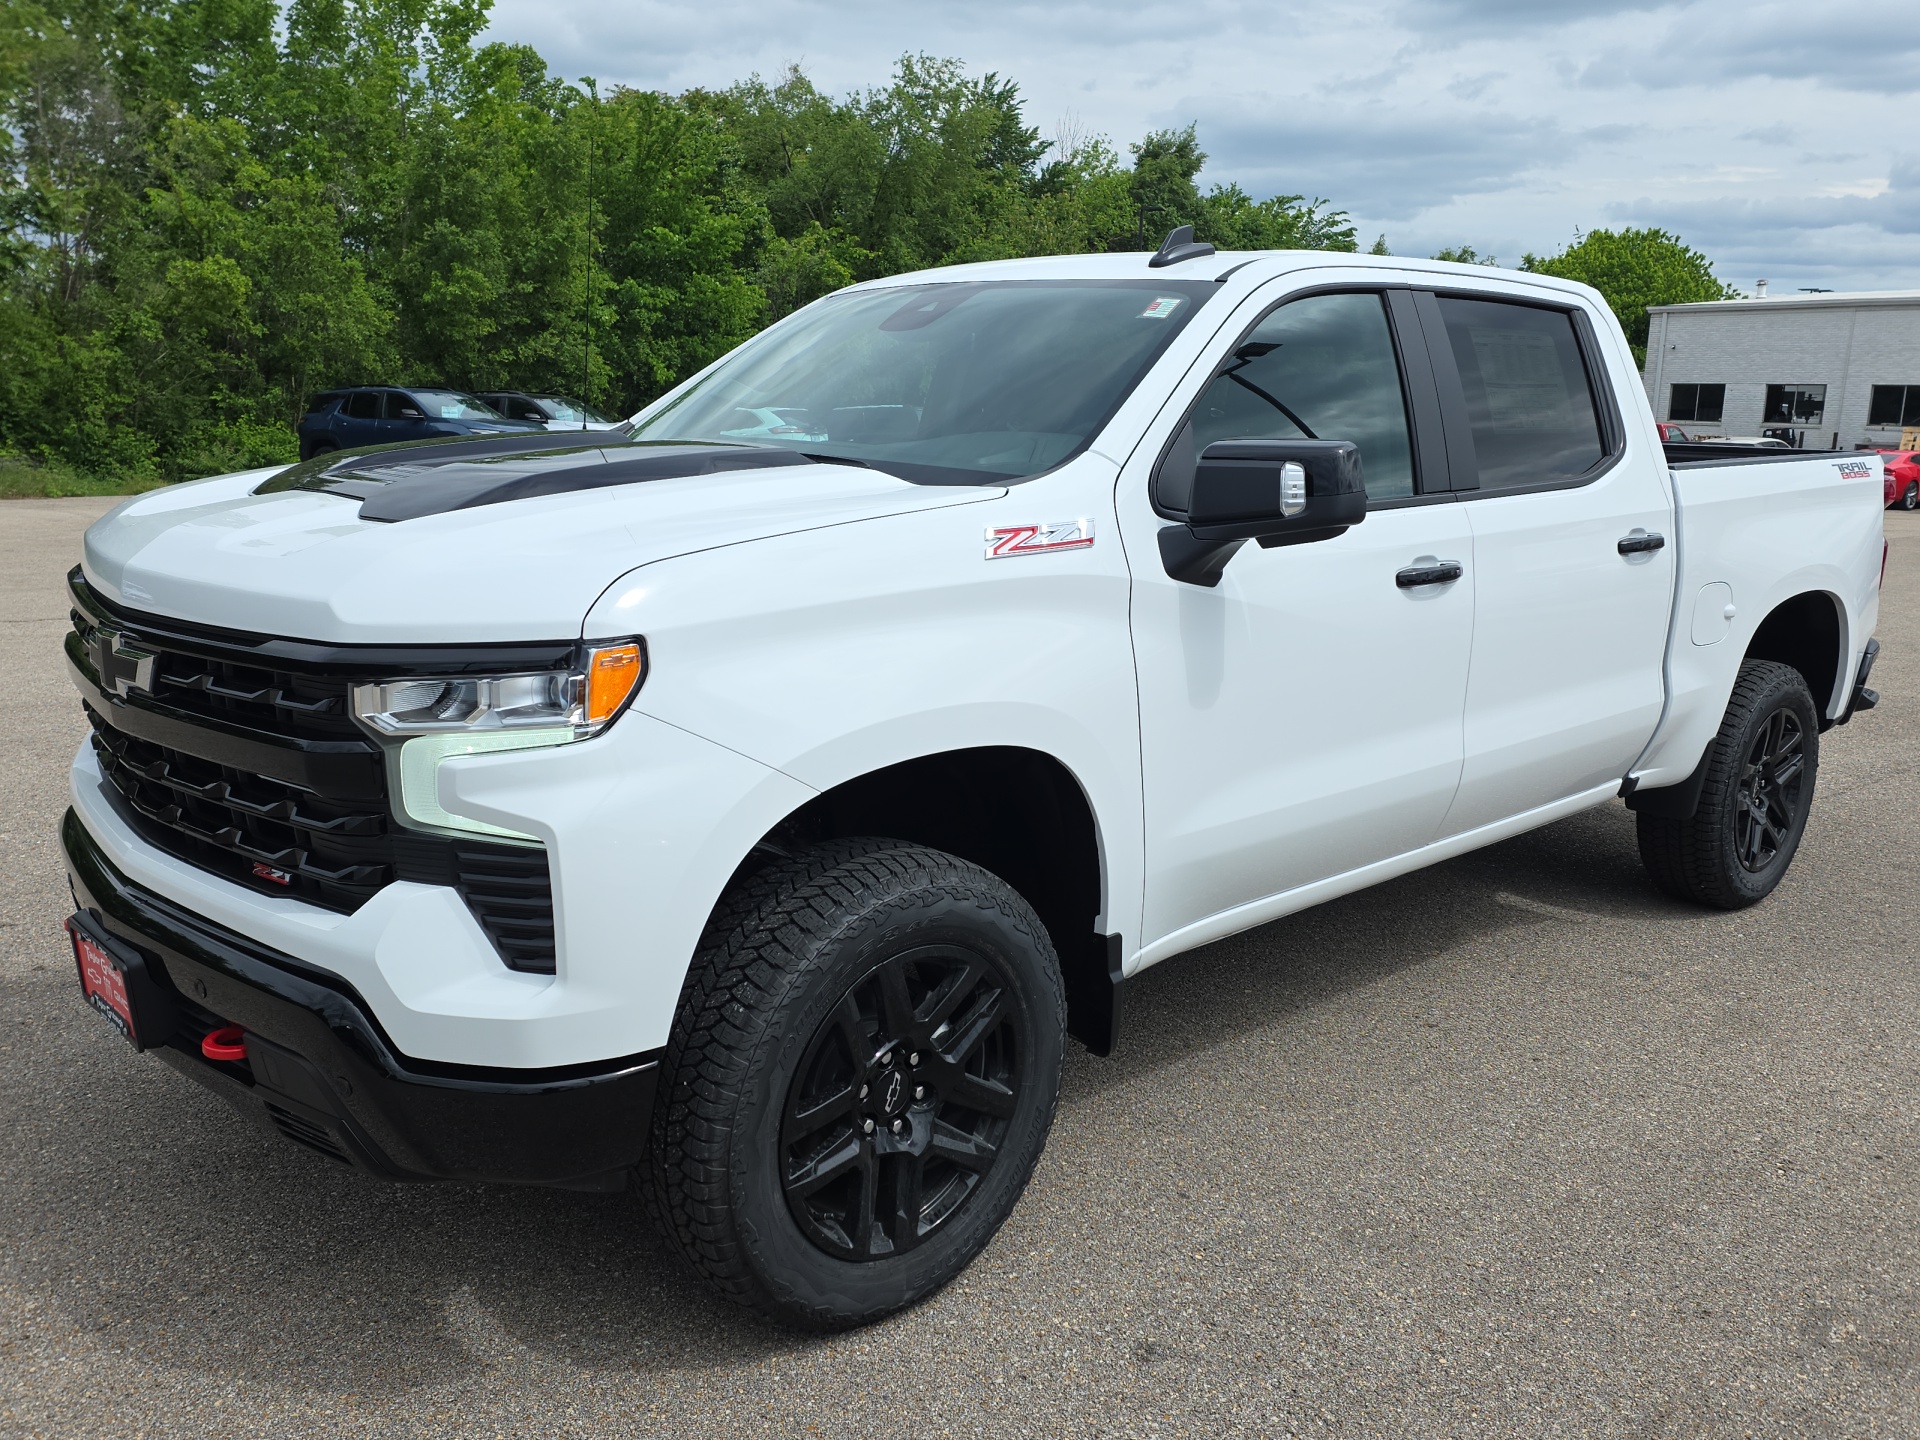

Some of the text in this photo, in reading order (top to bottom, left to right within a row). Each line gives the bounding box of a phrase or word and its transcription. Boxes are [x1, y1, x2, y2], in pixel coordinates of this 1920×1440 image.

[1831, 462, 1873, 473] TRAIL
[1841, 471, 1871, 480] BOSS
[984, 518, 1096, 560] Z71
[252, 862, 292, 886] Z71
